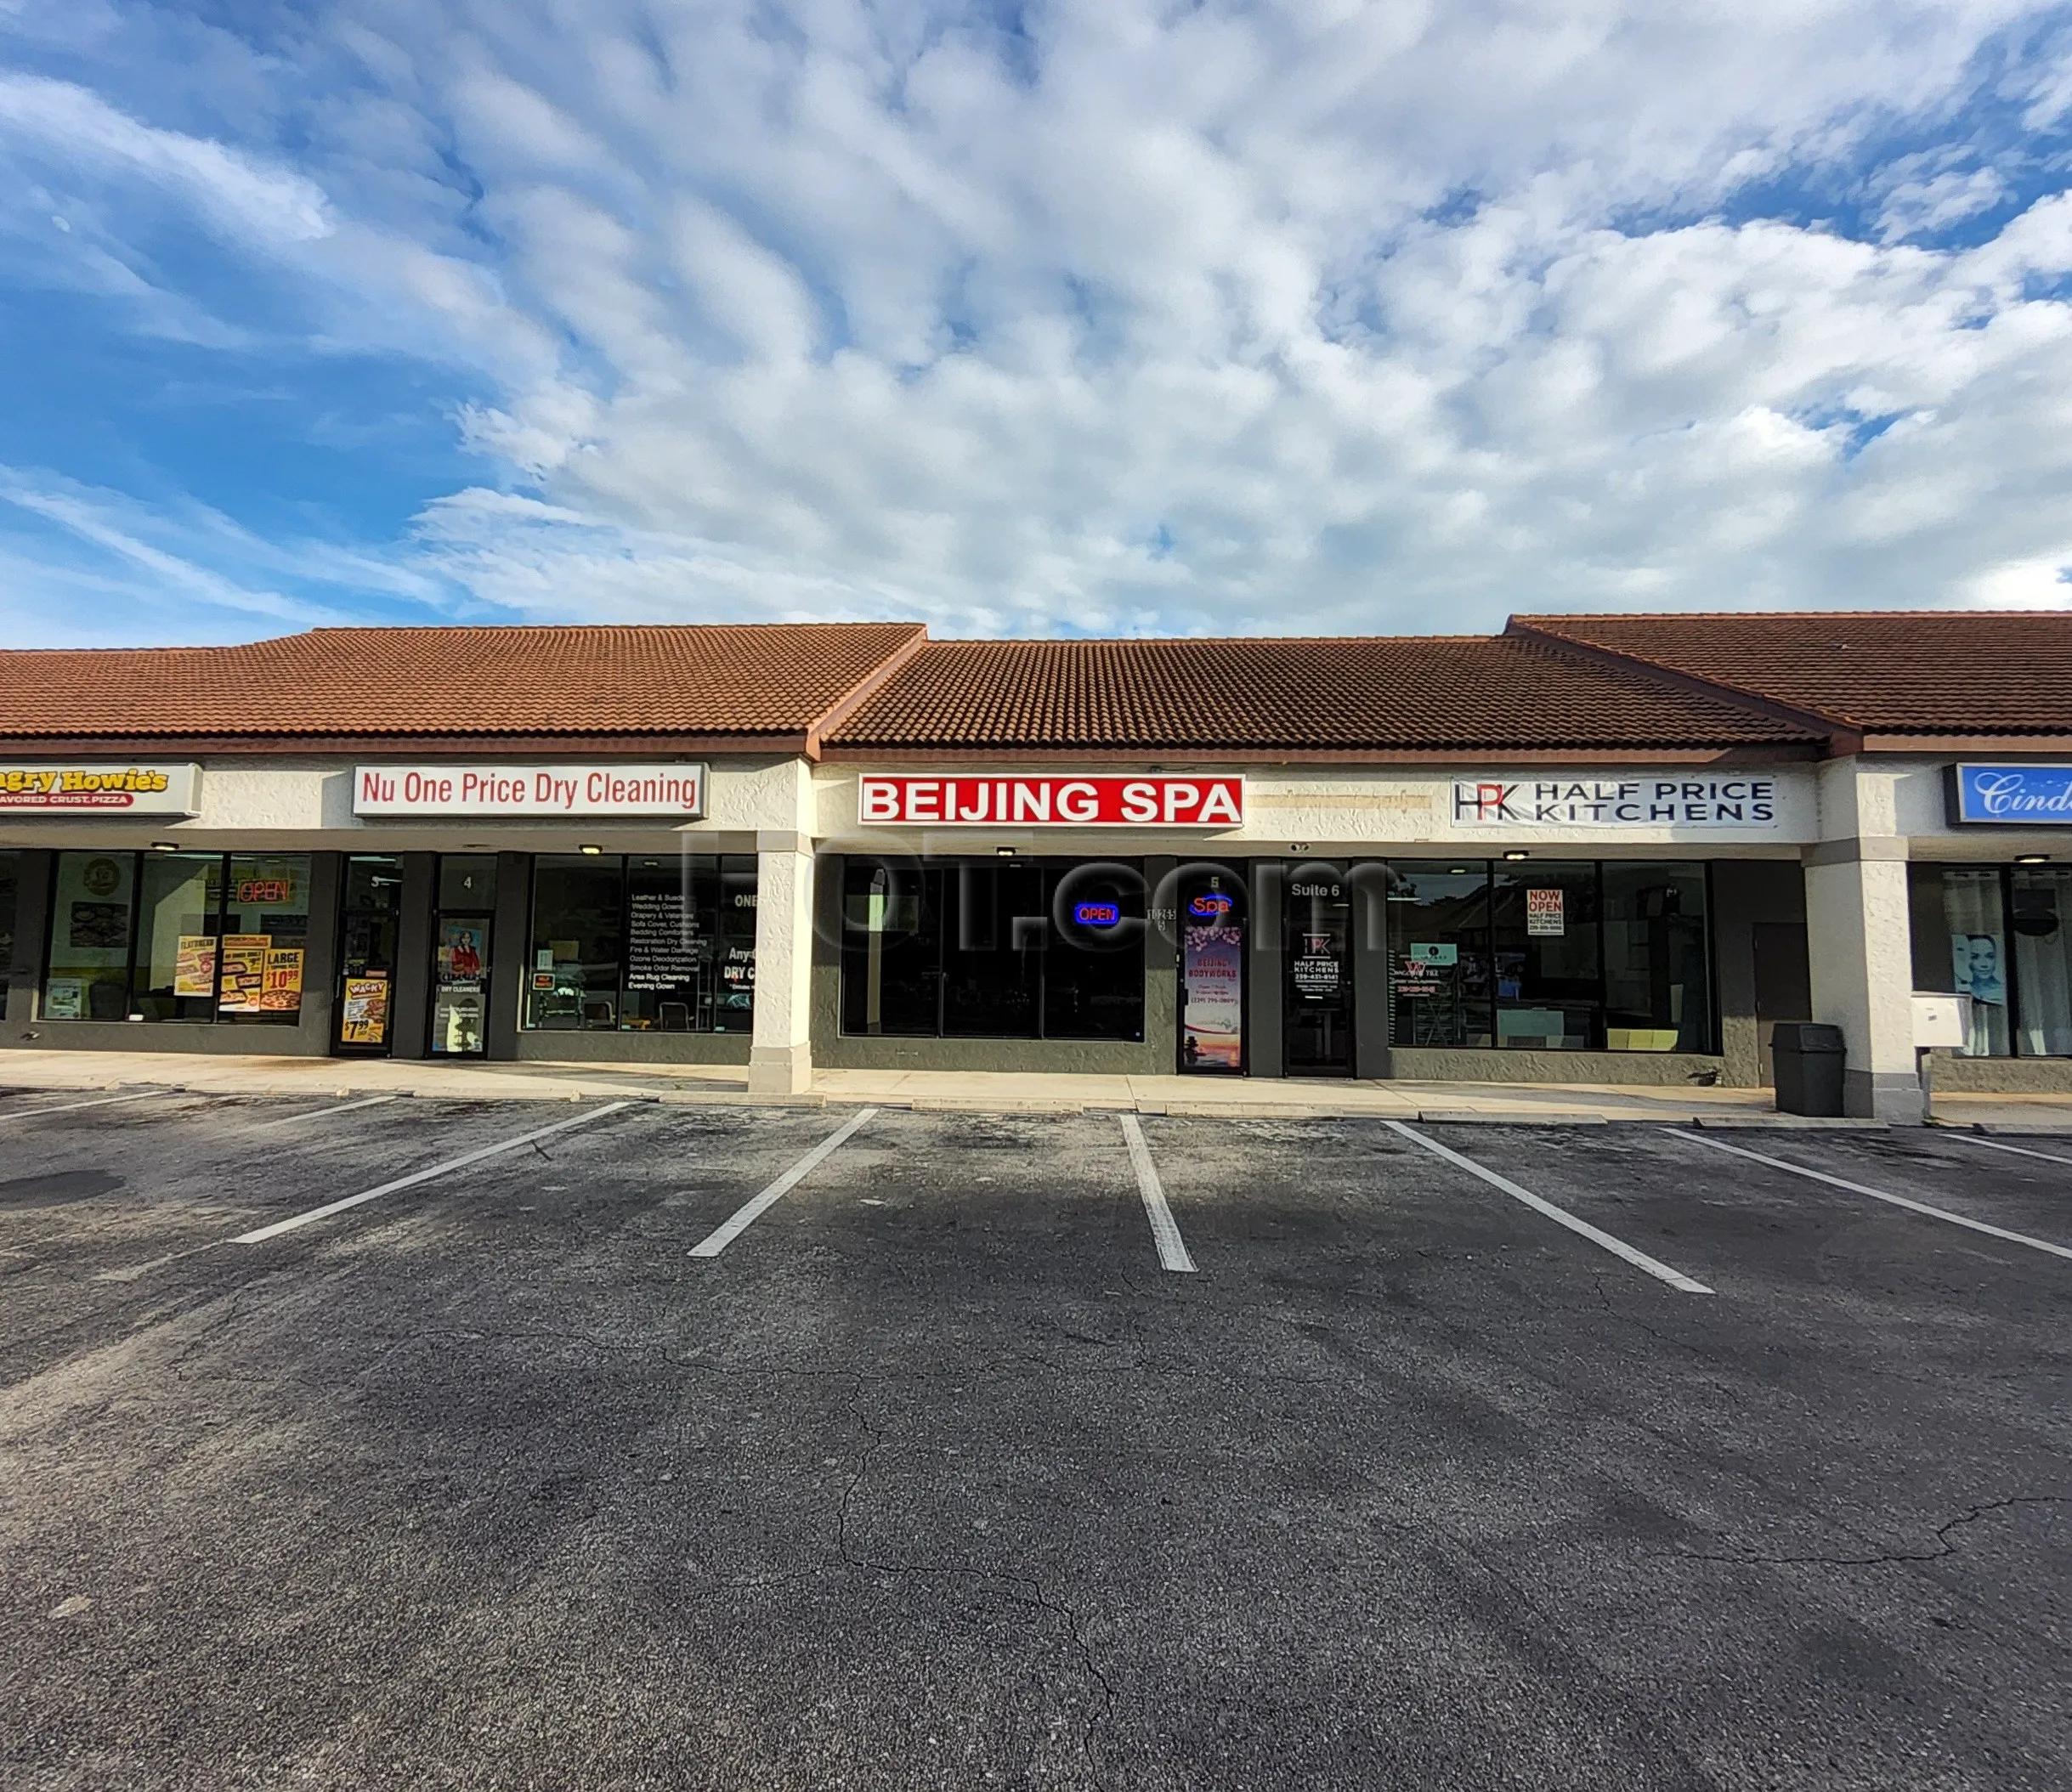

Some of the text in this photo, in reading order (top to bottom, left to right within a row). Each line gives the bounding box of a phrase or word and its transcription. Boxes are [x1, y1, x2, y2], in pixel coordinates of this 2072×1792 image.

[62, 768, 168, 792] Howie's
[363, 772, 696, 809] Nu One Price Dry Cleaning
[1536, 782, 1774, 800] HALF PRICE
[49, 795, 91, 804] CRUST
[92, 795, 127, 804] PIZZA
[863, 782, 1242, 823] BEIJING SPA
[1536, 803, 1774, 822] KITCHENS
[463, 876, 472, 889] 4
[241, 881, 286, 902] OPEN
[1292, 884, 1340, 897] Suite 6
[1530, 890, 1560, 902] NOW
[631, 902, 660, 911] Wedding
[1194, 897, 1229, 913] Spa
[1529, 902, 1562, 913] OPEN
[1078, 907, 1115, 921] OPEN
[679, 938, 707, 947] Cleaning
[267, 952, 299, 964] LARGE
[729, 947, 749, 963] Any
[646, 973, 660, 981] Rug
[660, 973, 690, 982] Cleaning
[724, 966, 745, 980] DRY
[349, 982, 384, 994] WACKY
[628, 981, 654, 990] Evening
